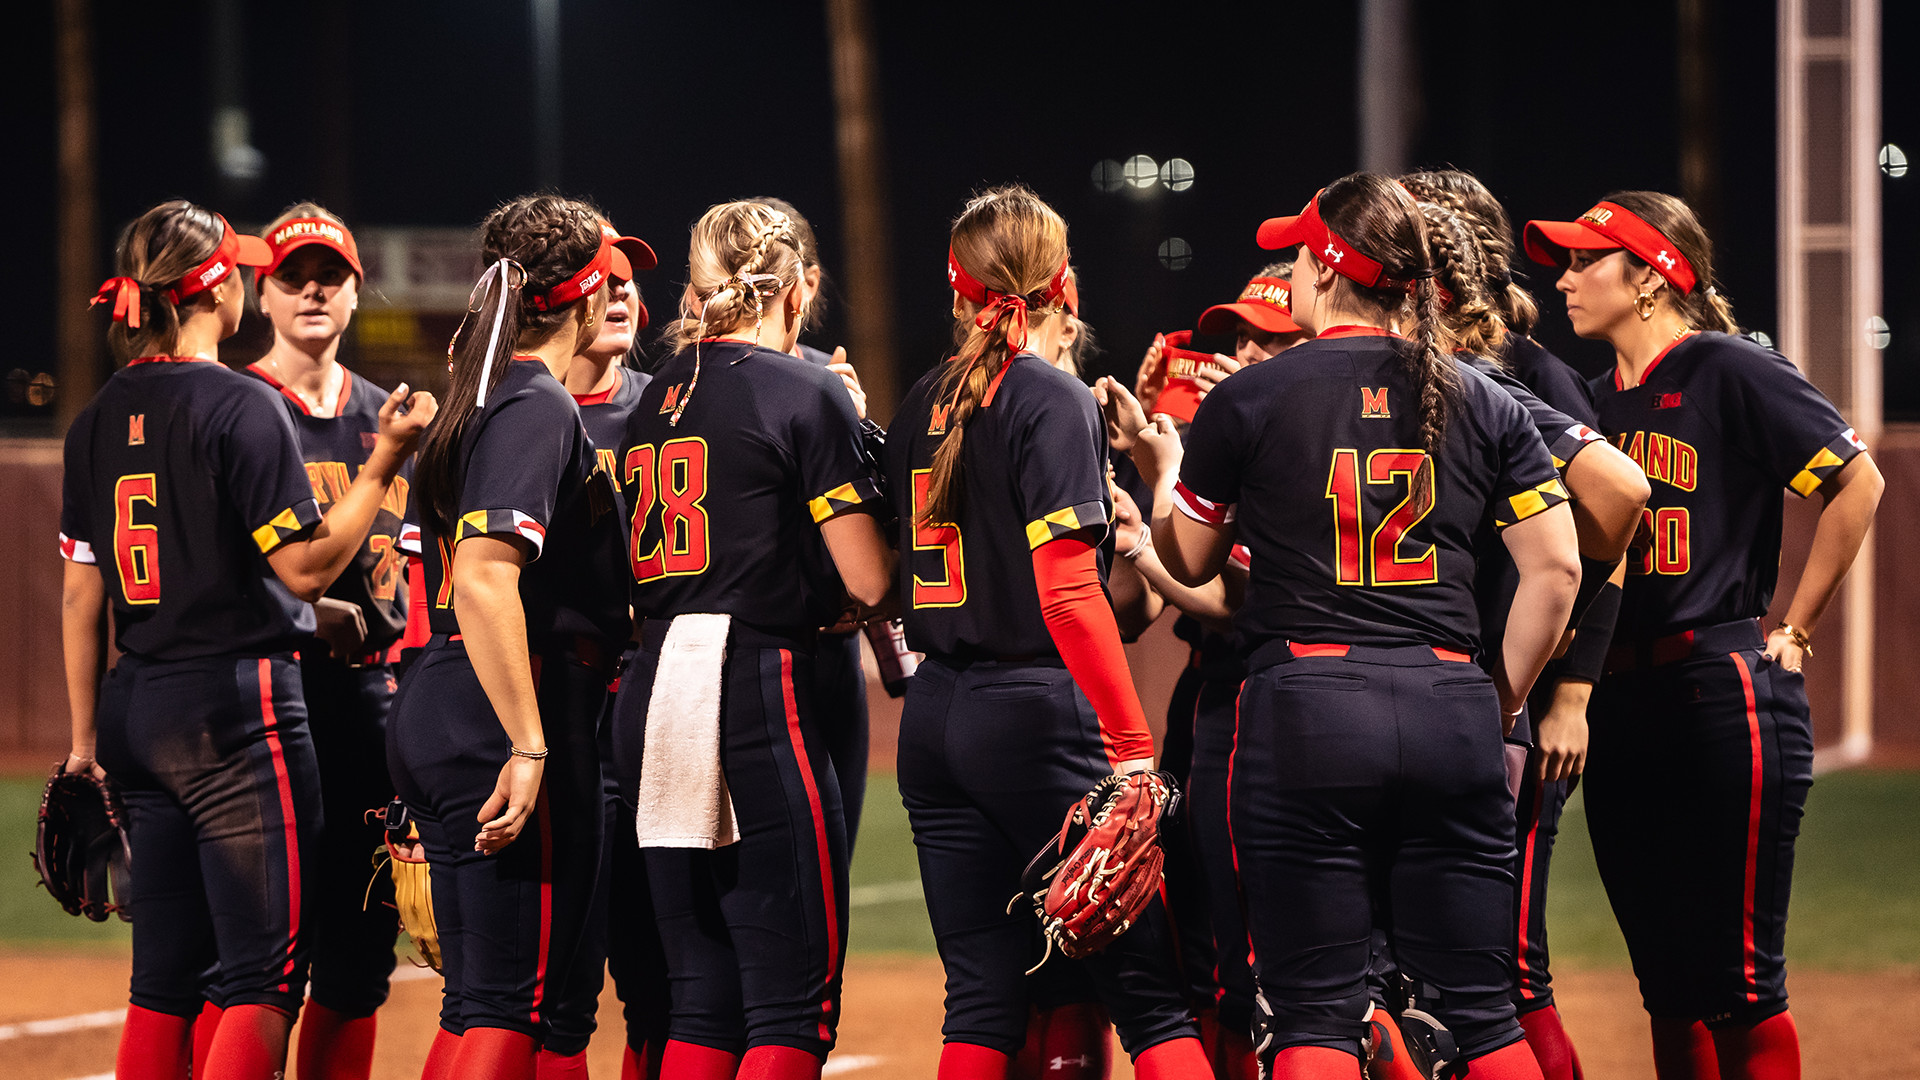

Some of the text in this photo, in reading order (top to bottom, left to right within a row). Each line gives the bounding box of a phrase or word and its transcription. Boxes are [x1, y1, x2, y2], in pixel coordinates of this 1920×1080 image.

[274, 222, 344, 245] MARYLAND
[658, 383, 684, 414] M
[928, 404, 950, 435] M
[1360, 386, 1390, 418] M
[128, 414, 145, 445] M
[625, 436, 710, 584] 28
[1325, 448, 1438, 586] 12
[113, 473, 160, 605] 6
[911, 468, 967, 609] 5
[369, 534, 400, 601] 2
